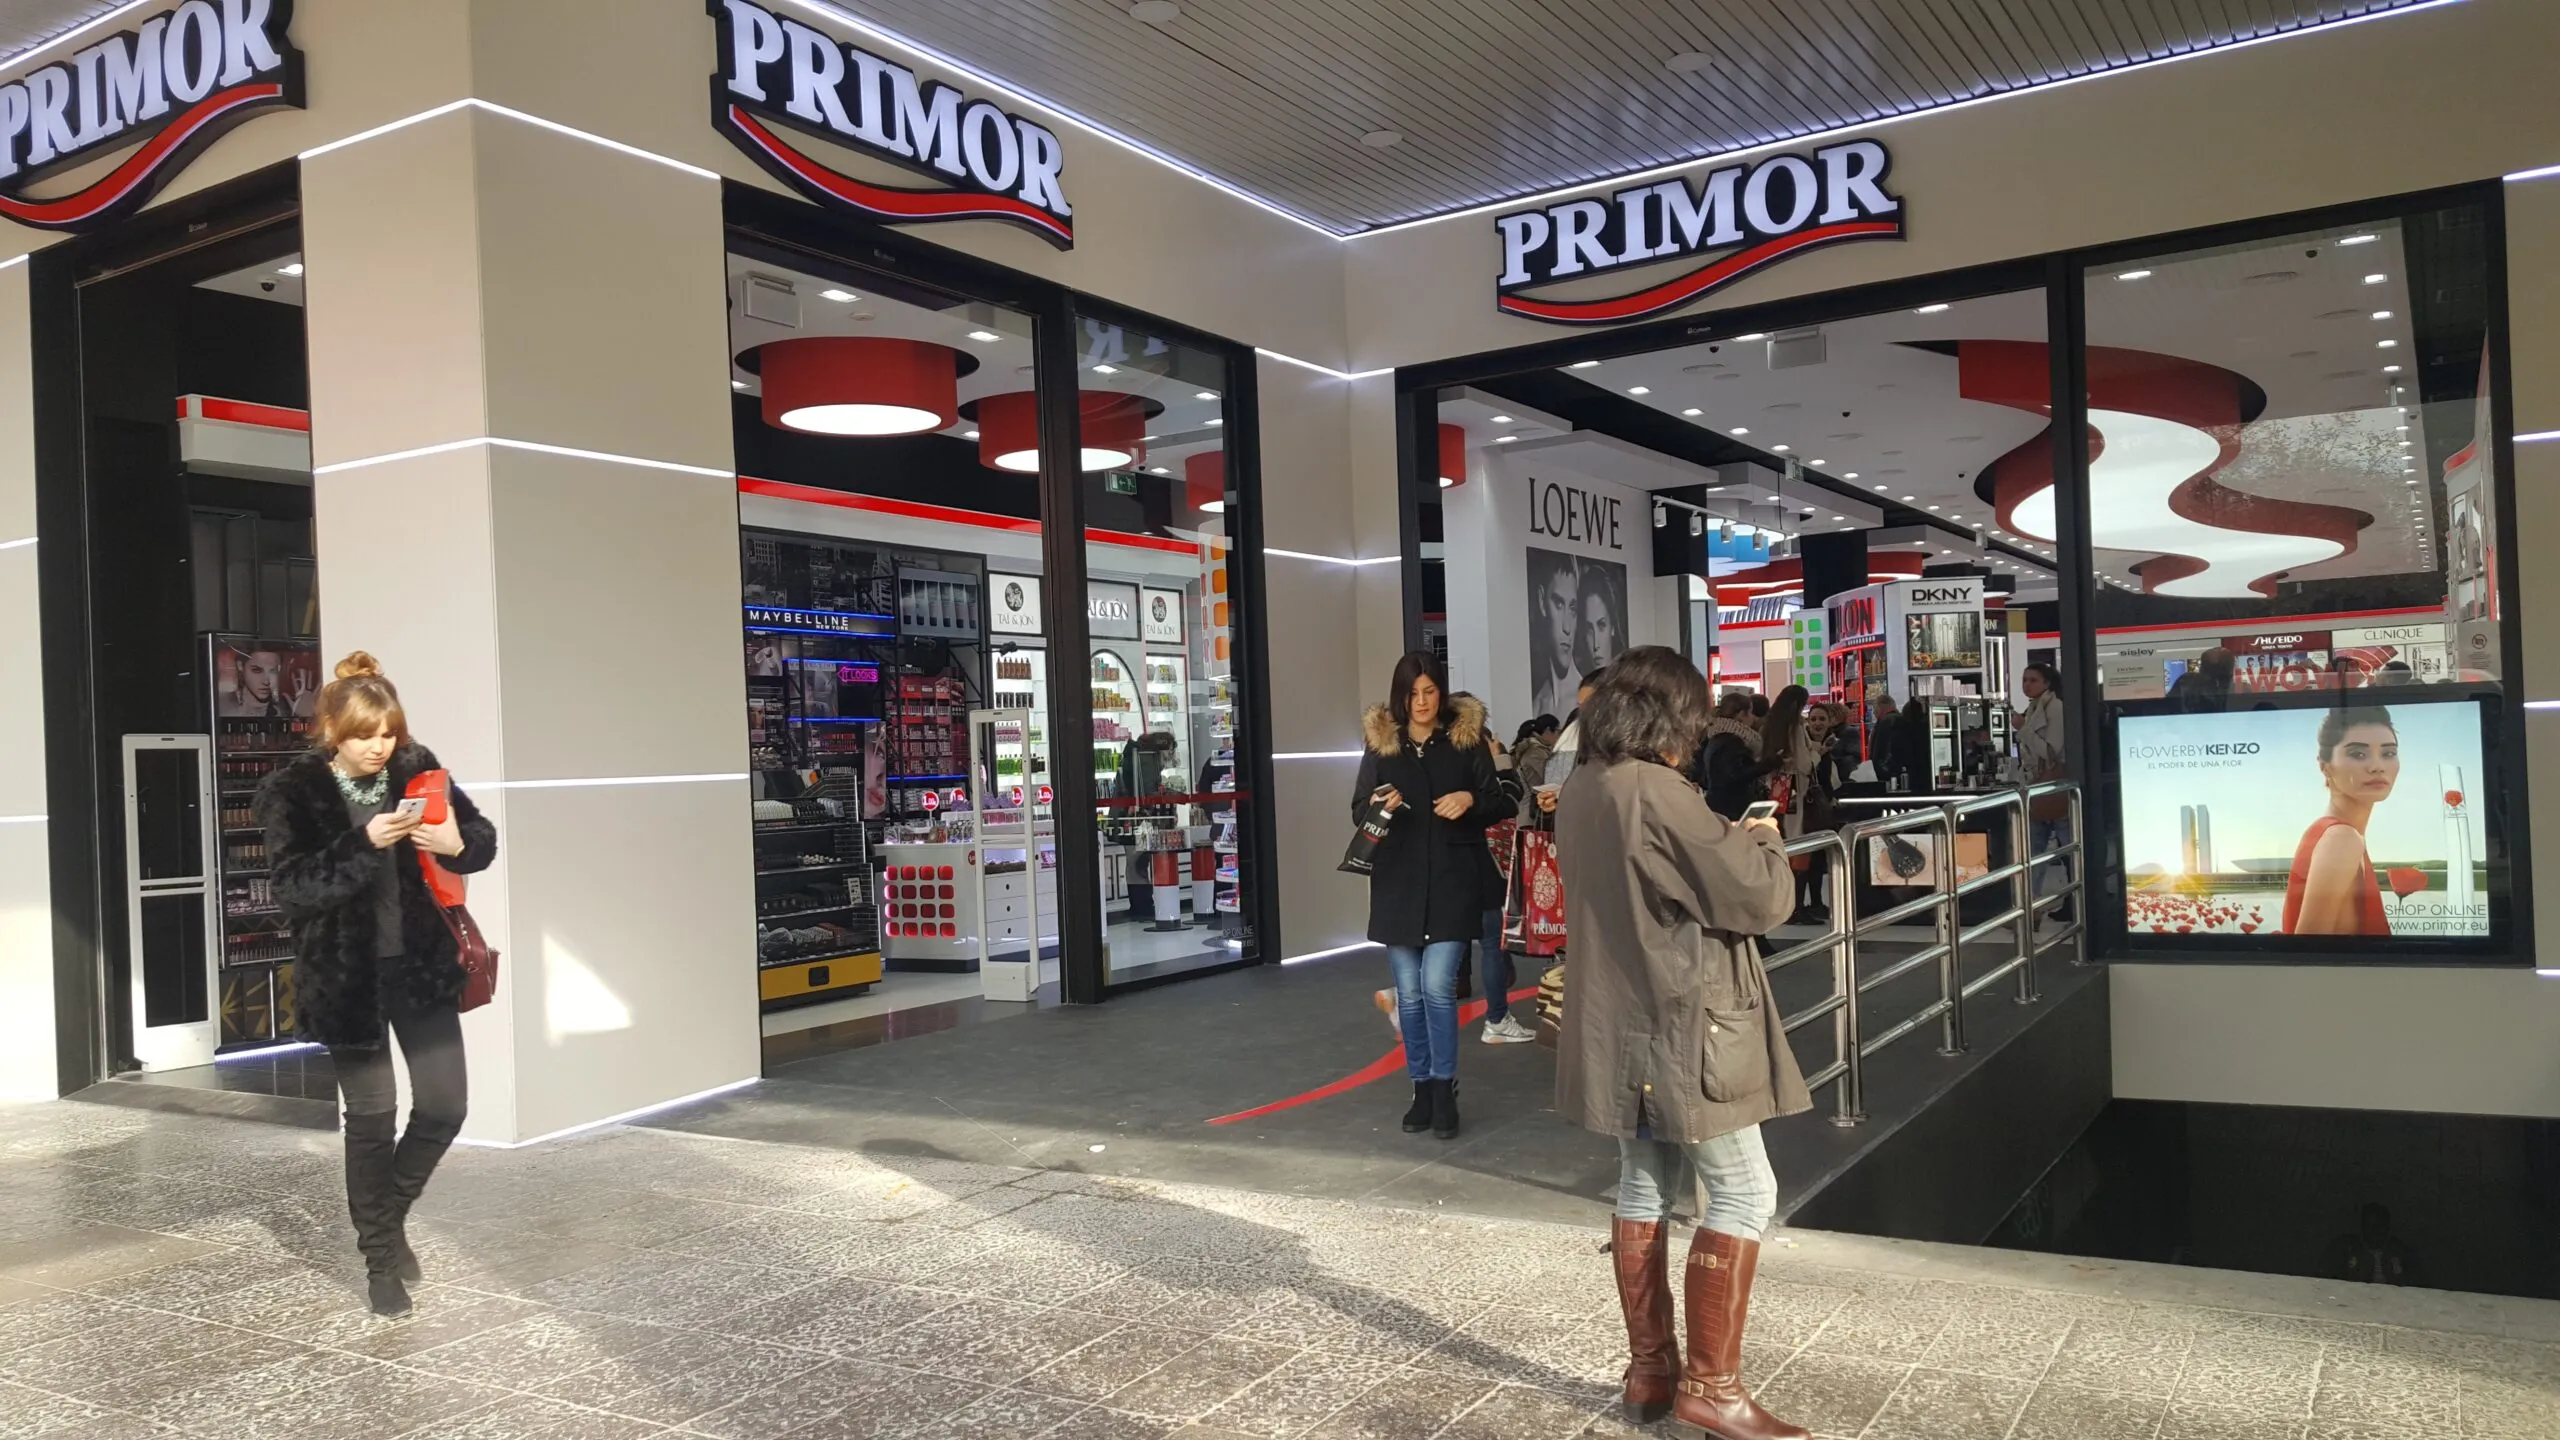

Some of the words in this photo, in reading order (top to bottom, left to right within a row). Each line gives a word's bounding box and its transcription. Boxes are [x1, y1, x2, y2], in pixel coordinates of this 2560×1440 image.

[0, 0, 281, 176] PRIMOR
[724, 0, 1072, 216] PRIMOR
[1498, 139, 1898, 286] PRIMOR
[1528, 477, 1623, 550] LOEWE
[1912, 587, 1972, 602] DKNY
[750, 610, 849, 626] MAYBELLINE
[2250, 634, 2303, 646] SHISEIDO
[2364, 627, 2423, 641] CLINIQUE
[2119, 648, 2155, 657] sisley
[850, 669, 878, 681] LOOKS
[2158, 761, 2185, 769] PODER
[2187, 760, 2198, 768] DE
[2200, 760, 2220, 768] UNA
[2222, 759, 2243, 767] FLOR
[2385, 904, 2426, 916] SHOP
[2431, 904, 2487, 916] ONLINE
[2388, 918, 2488, 932] www.primor.eu
